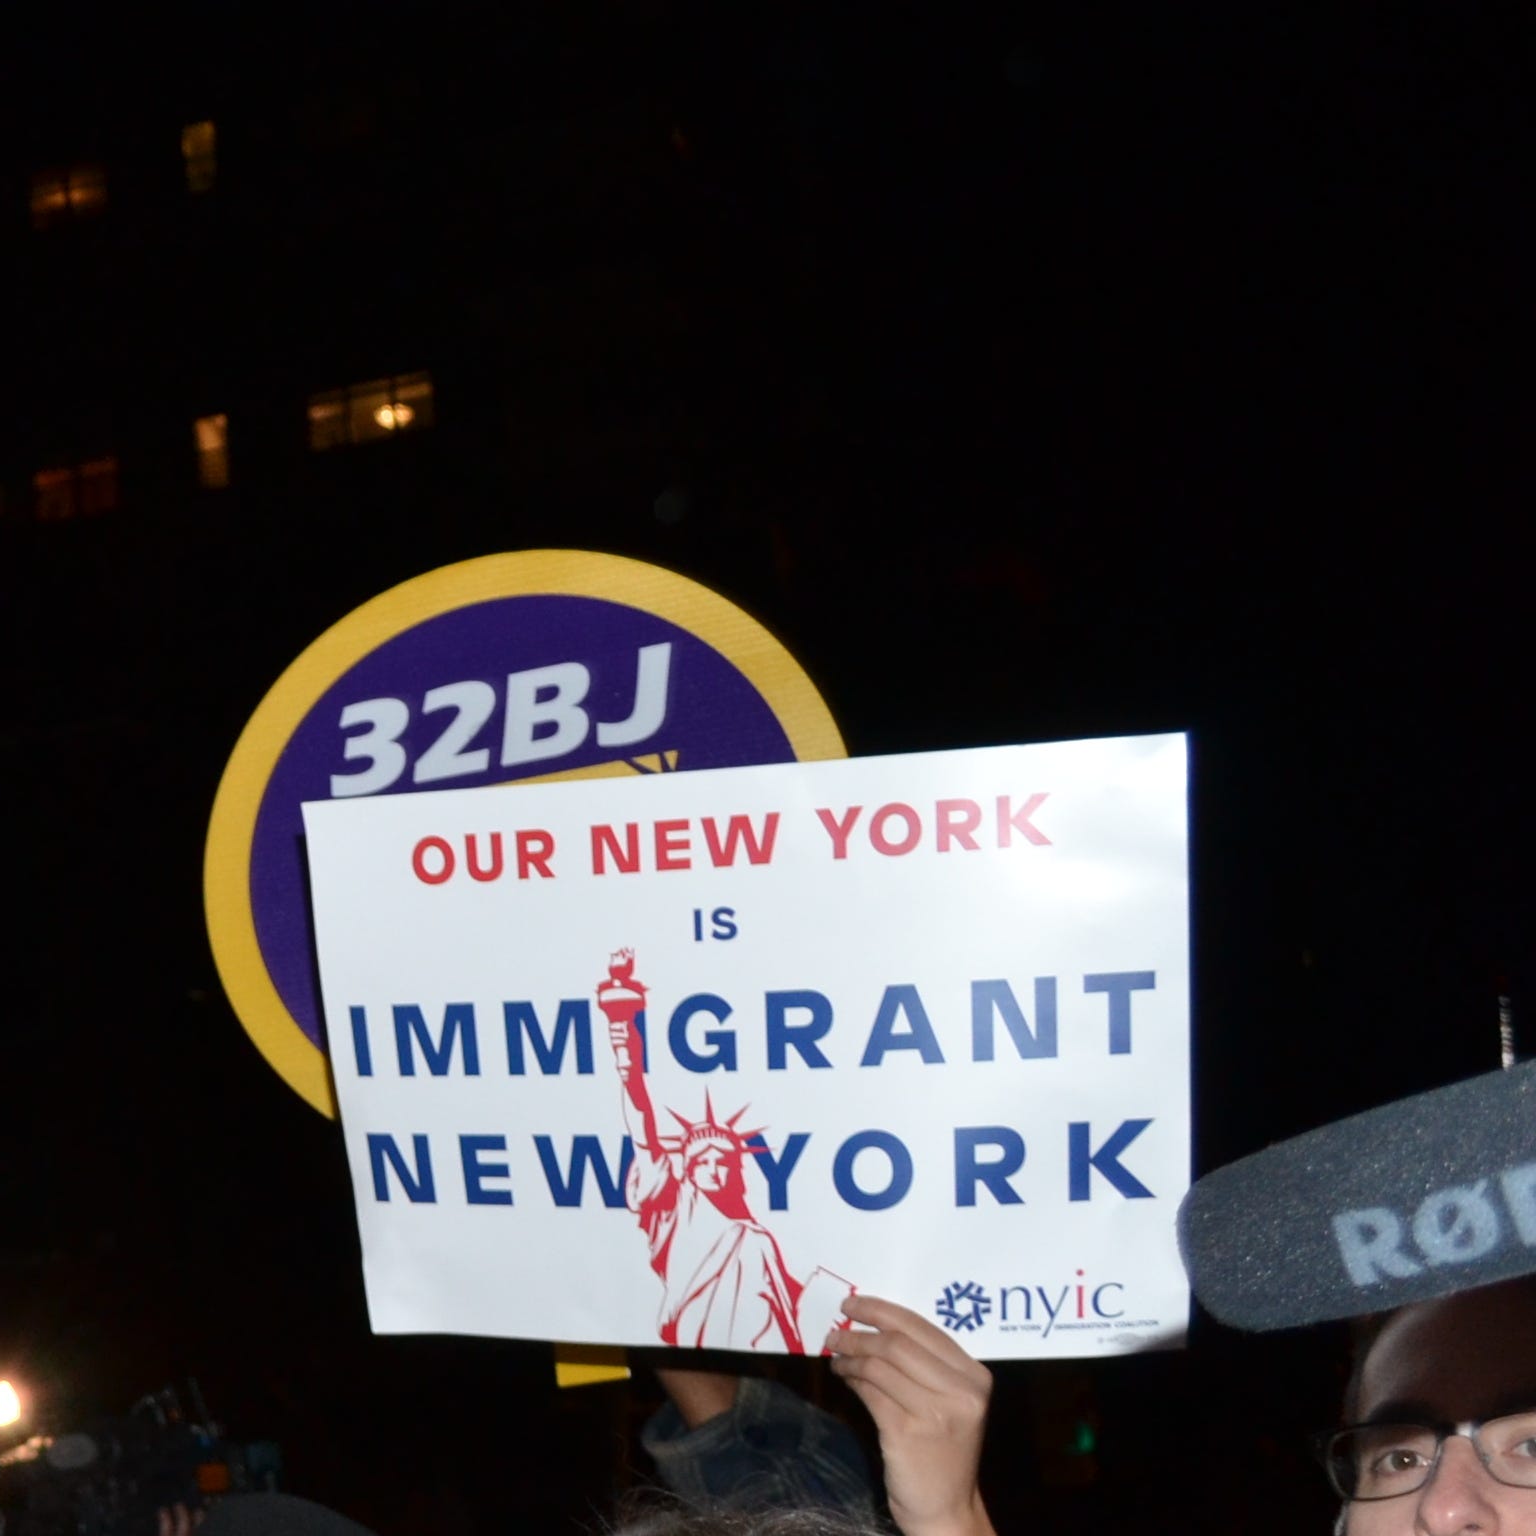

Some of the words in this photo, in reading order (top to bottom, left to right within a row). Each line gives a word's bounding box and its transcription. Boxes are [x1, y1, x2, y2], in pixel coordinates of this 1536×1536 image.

[330, 642, 672, 798] 32BJ
[411, 829, 556, 886] OUR
[590, 812, 781, 876] NEW
[815, 793, 1052, 861] YORK
[693, 907, 738, 942] IS
[366, 1132, 635, 1210] NEW
[744, 1118, 1155, 1212] YORK
[1000, 1268, 1124, 1339] nyic
